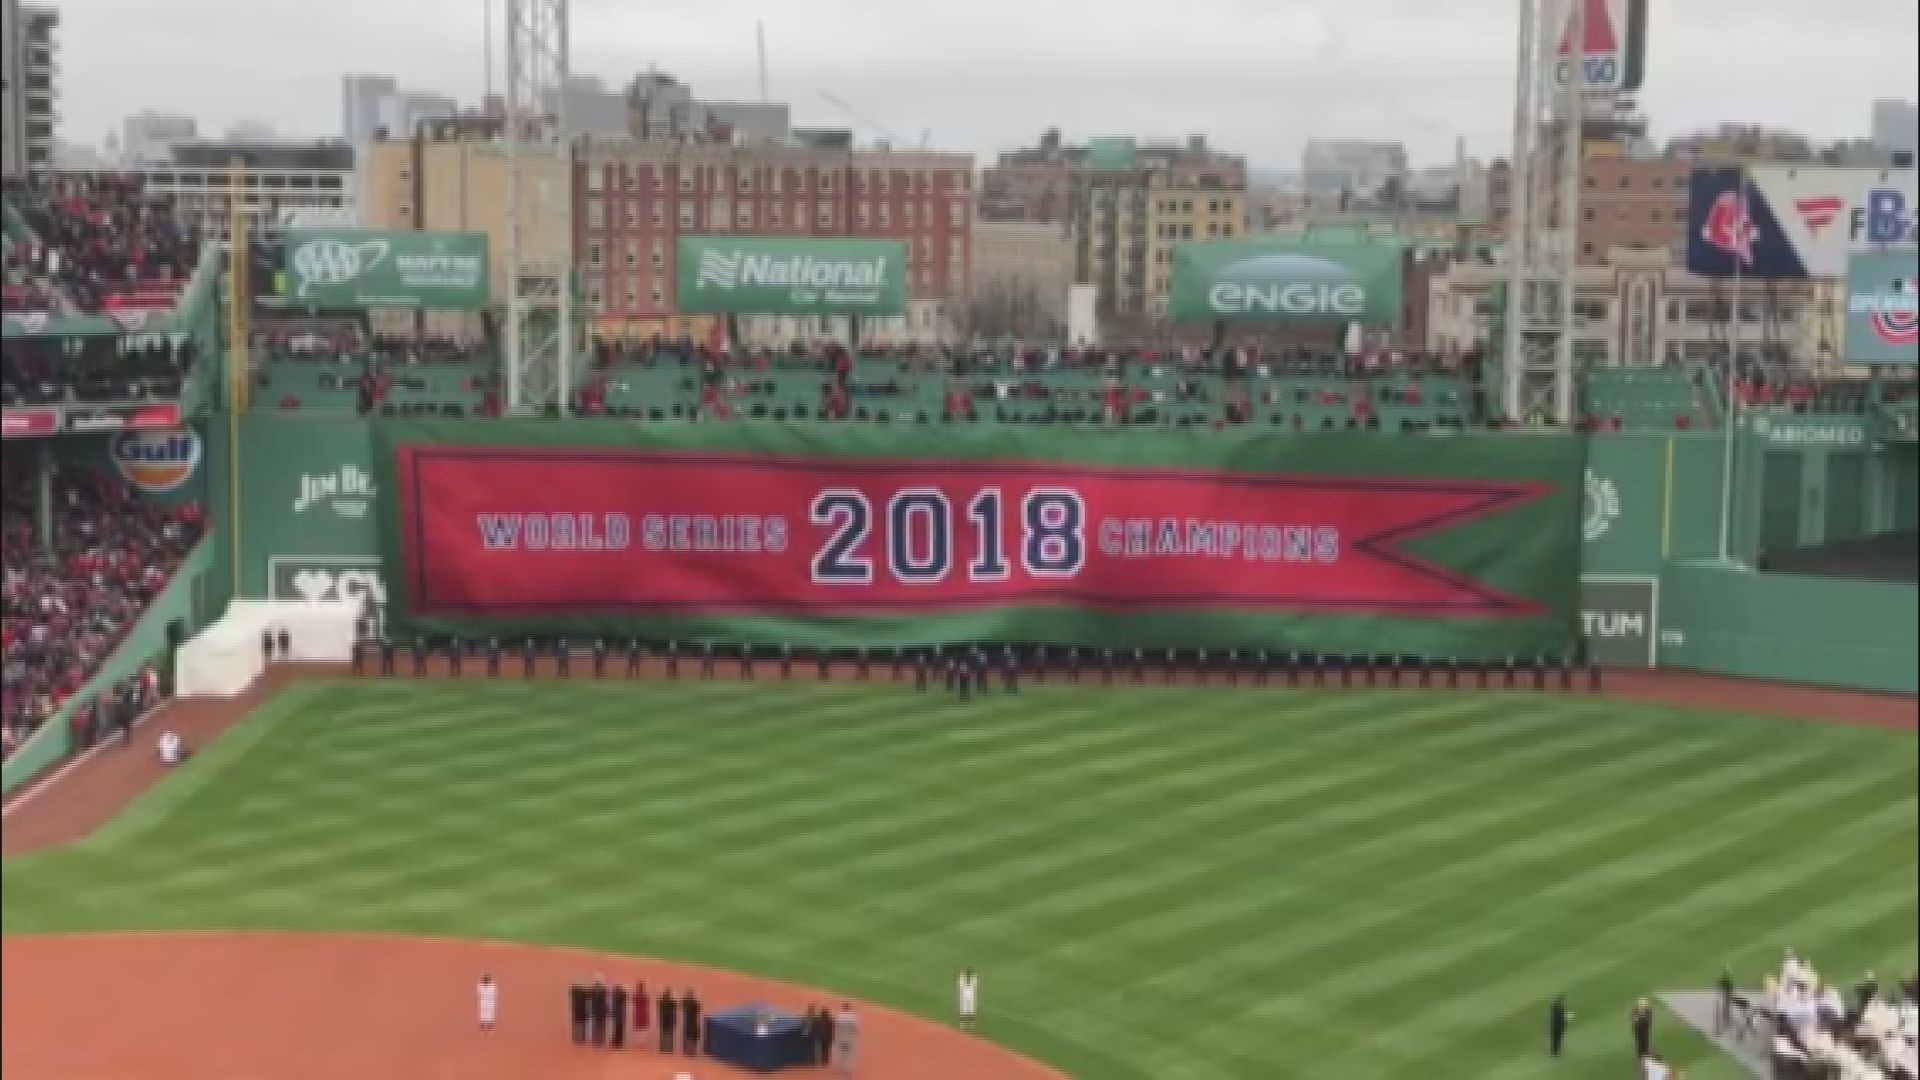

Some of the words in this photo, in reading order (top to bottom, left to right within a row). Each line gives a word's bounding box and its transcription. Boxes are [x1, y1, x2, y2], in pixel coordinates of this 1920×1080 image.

[743, 254, 888, 284] National
[120, 438, 191, 462] Gulf
[477, 512, 630, 551] WORLD
[642, 514, 789, 553] SERIES
[809, 488, 1086, 583] 2018
[1099, 517, 1339, 564] CHAMPIONS
